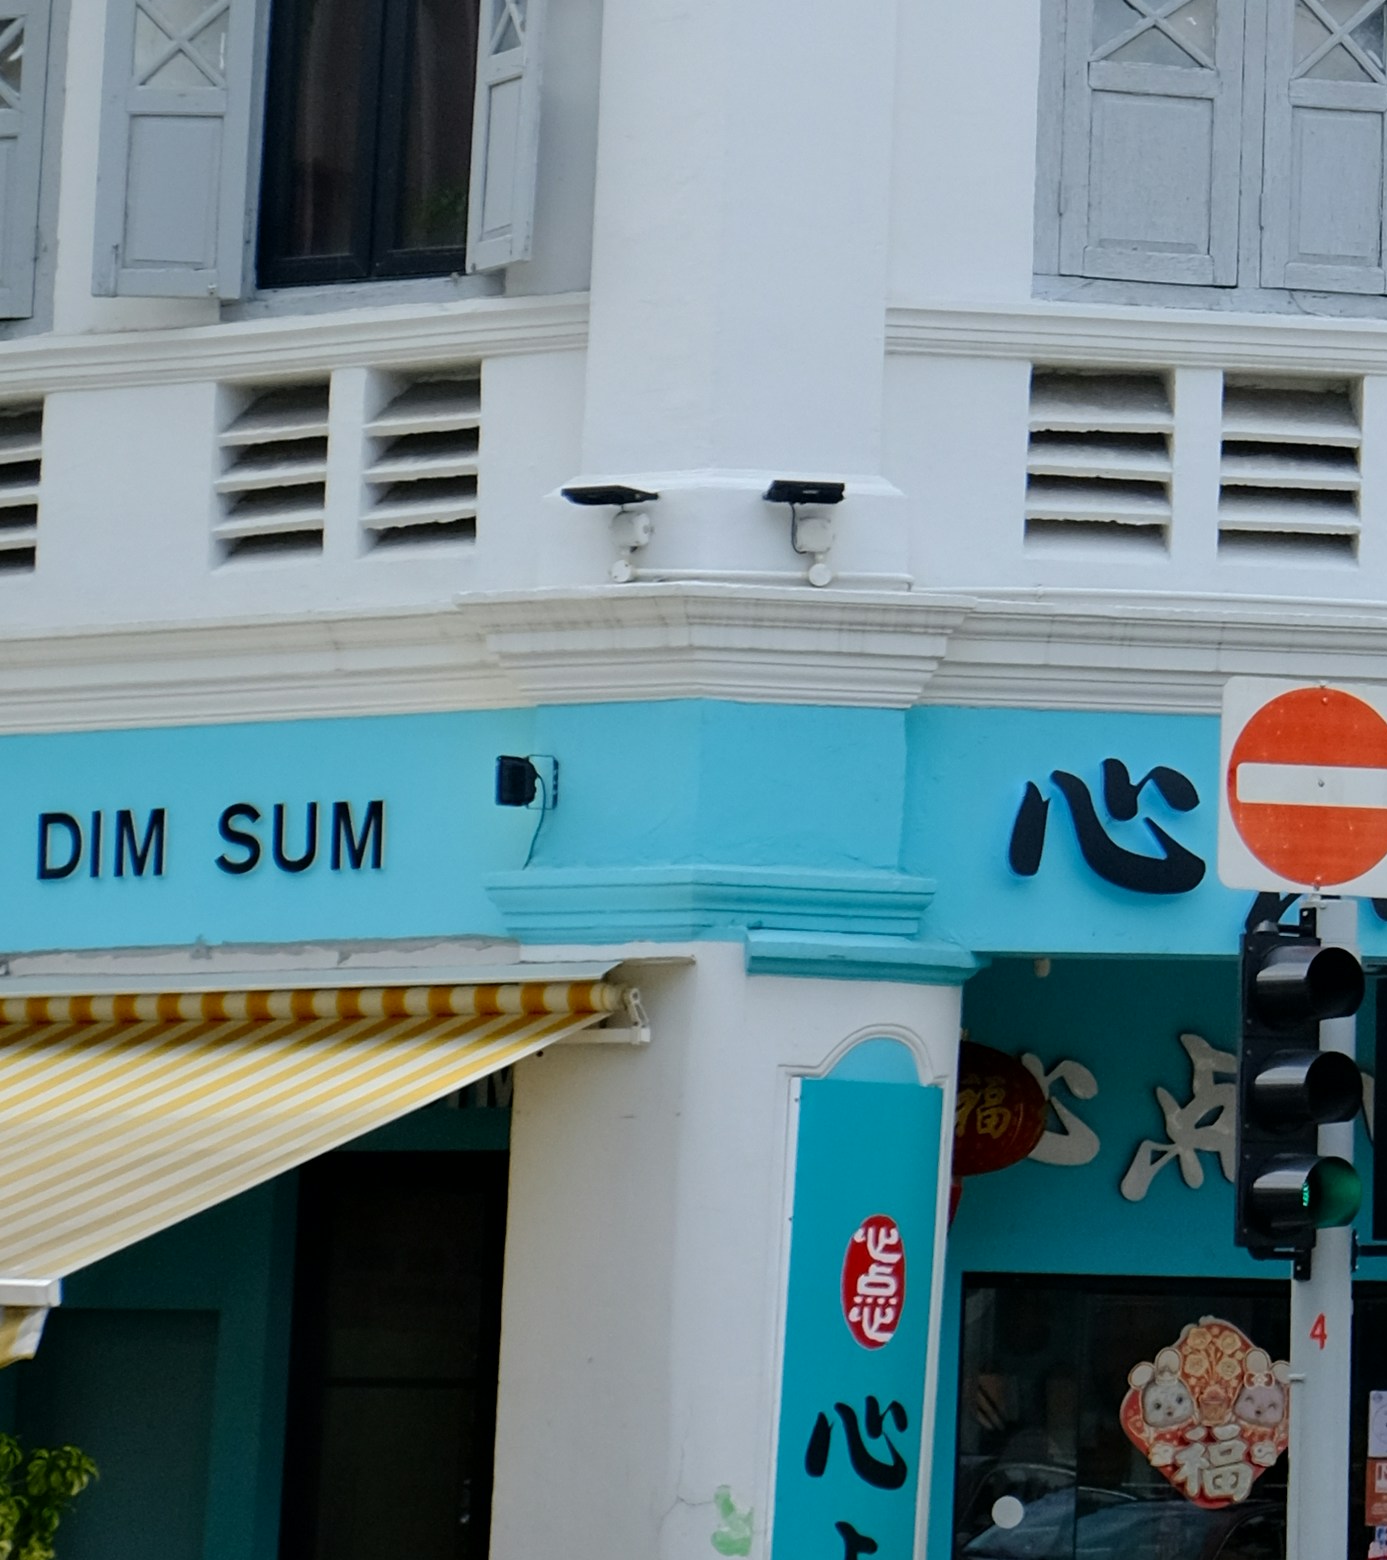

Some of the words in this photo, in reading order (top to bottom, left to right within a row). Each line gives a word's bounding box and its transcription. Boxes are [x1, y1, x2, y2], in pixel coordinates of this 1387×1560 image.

[36, 807, 168, 881] DIM
[214, 799, 386, 876] SUM
[1309, 1312, 1328, 1350] 4
[1173, 1423, 1255, 1504] 福
